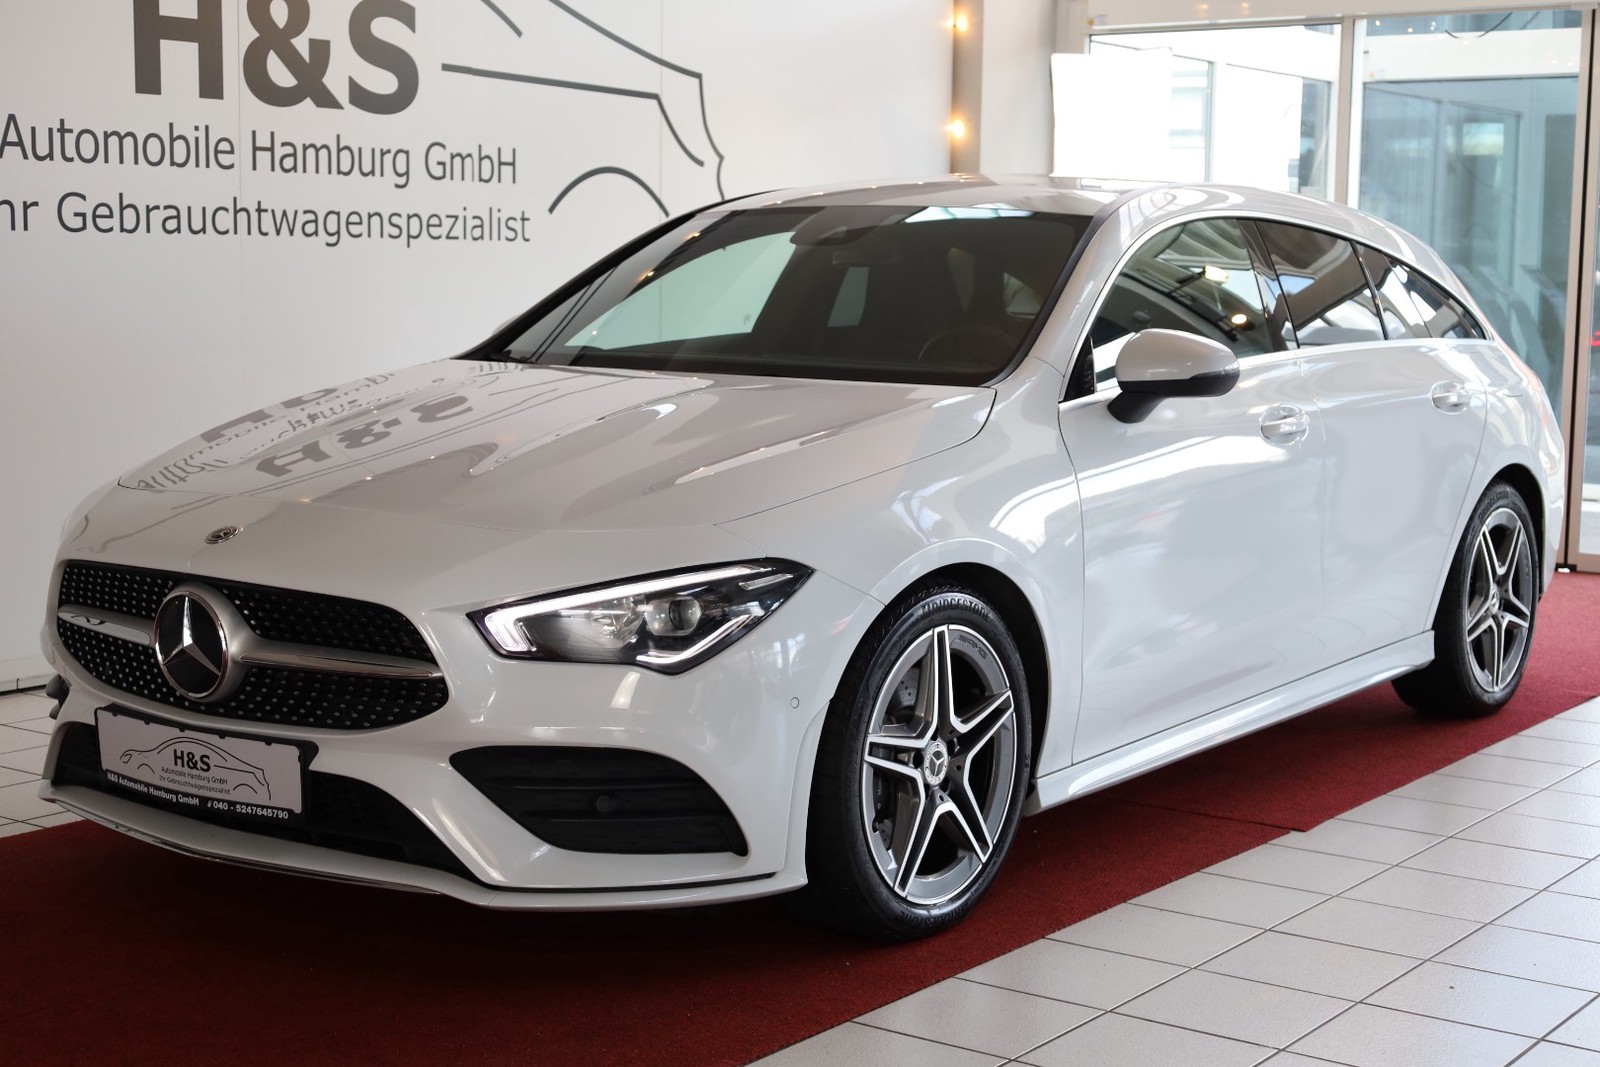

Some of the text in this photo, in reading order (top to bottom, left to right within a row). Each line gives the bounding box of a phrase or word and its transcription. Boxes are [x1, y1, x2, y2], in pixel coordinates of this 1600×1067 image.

[133, 0, 420, 115] H&S
[0, 113, 517, 189] Automobile Hamburg GmbH
[57, 191, 531, 248] Gebrauchtwagenspezialist
[161, 766, 228, 786] Automobile Hamburg GmbH
[173, 748, 211, 773] H&S
[107, 771, 118, 783] H&S
[119, 776, 148, 793] Automobile
[148, 786, 177, 802] Hamburg
[178, 794, 200, 806] GmbH
[213, 800, 229, 810] 040
[235, 804, 289, 819] 5247645790
